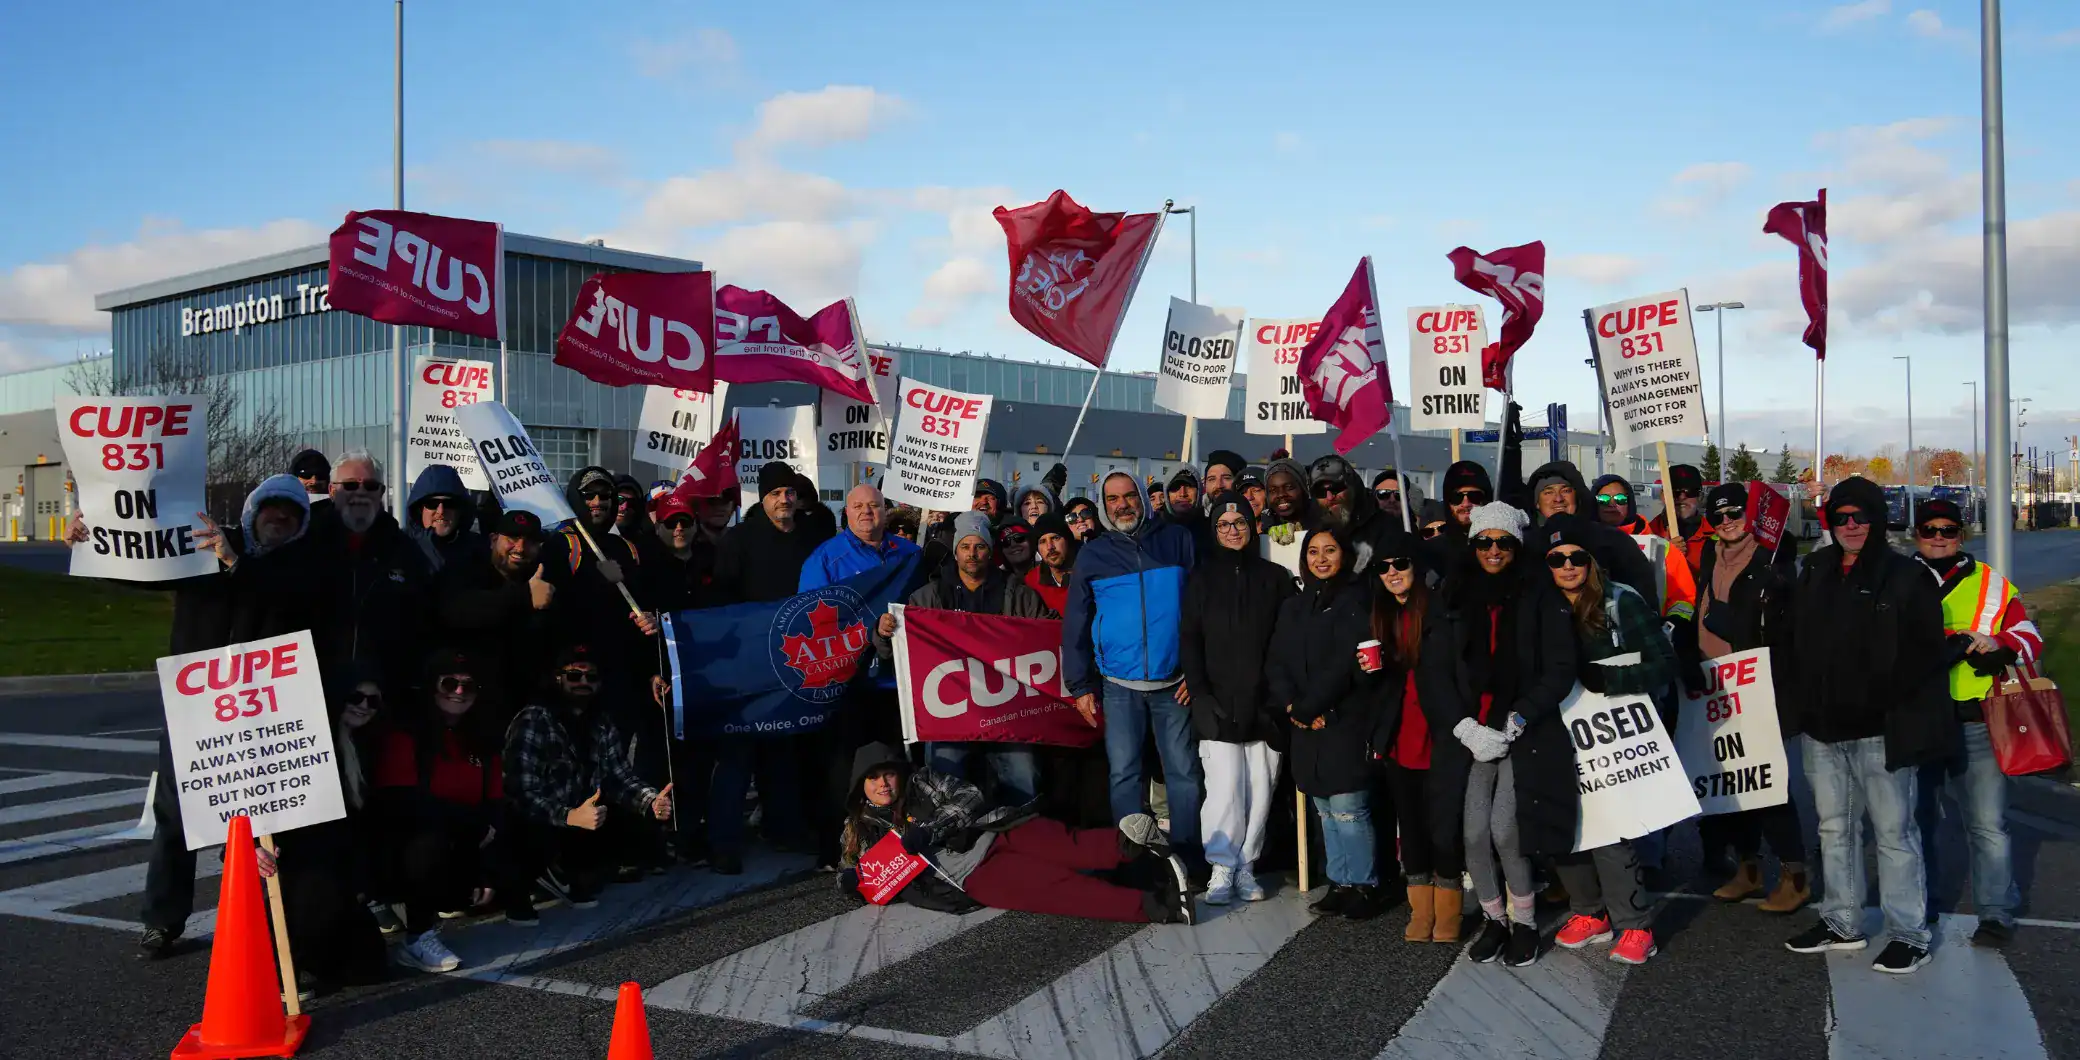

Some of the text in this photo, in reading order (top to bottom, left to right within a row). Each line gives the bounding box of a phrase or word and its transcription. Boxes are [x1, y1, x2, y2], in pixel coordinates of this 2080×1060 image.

[182, 294, 283, 336] Brampton
[1416, 310, 1478, 333] CUPE
[1597, 299, 1678, 338] CUPE
[1256, 322, 1322, 344] CUPE
[1433, 335, 1469, 354] 831
[1167, 331, 1235, 360] CLOSED
[1620, 332, 1664, 359] 831
[1163, 365, 1228, 385] MANAGEMENT
[1167, 355, 1226, 373] DUE TO POOR
[1614, 358, 1682, 380] WHY IS THERE
[423, 363, 489, 389] CUPE
[1280, 376, 1300, 395] ON
[1439, 365, 1466, 387] ON
[1611, 371, 1690, 396] ALWAYS MONEY
[906, 388, 984, 419] CUPE
[1422, 394, 1480, 415] STRIKE
[1608, 384, 1699, 410] FOR MANAGEMENT
[69, 404, 193, 438] CUPE
[425, 414, 450, 424] WHY
[671, 410, 697, 432] ON
[846, 405, 869, 424] ON
[1624, 400, 1686, 421] BUT NOT FOR
[417, 426, 460, 437] ALWAYS
[921, 415, 960, 438] 831
[1629, 414, 1684, 433] WORKERS?
[410, 438, 430, 447] FOR
[740, 439, 802, 459] CLOSE
[828, 430, 886, 451] STRIKE
[905, 435, 970, 455] WHY IS THERE
[102, 443, 164, 471] 831
[424, 452, 443, 460] BUT
[446, 454, 466, 462] NOT
[891, 455, 976, 477] FOR MANAGEMENT
[897, 445, 974, 466] ALWAYS MONEY
[497, 464, 523, 480] DUE
[524, 463, 541, 472] TO
[900, 470, 961, 488] BUT NOT FOR
[903, 483, 955, 499] WORKERS?
[114, 489, 158, 519] ON
[92, 525, 195, 559] STRIKE
[795, 629, 865, 665] ATU
[176, 642, 298, 696] CUPE
[806, 656, 857, 675] CANADA
[214, 685, 278, 722] 831
[1706, 692, 1742, 723] 831
[724, 714, 824, 733] One Voice. One
[979, 712, 1018, 728] Canadian
[1020, 707, 1043, 718] Union
[1044, 705, 1052, 713] of
[1571, 702, 1655, 750] OSED
[196, 719, 304, 751] WHY IS THERE
[190, 735, 317, 773] ALWAYS MONEY
[1587, 755, 1610, 772] TO
[1614, 740, 1660, 765] POOR
[1713, 732, 1745, 762] ON
[181, 751, 330, 793] FOR MANAGEMENT
[1578, 756, 1672, 796] NAGEMENT
[1694, 763, 1772, 799] STRIKE
[208, 774, 312, 807] BUT NOT FOR
[219, 793, 307, 823] WORKERS?
[873, 853, 908, 886] CUPE 831
[897, 861, 919, 881] BRAMPTON
